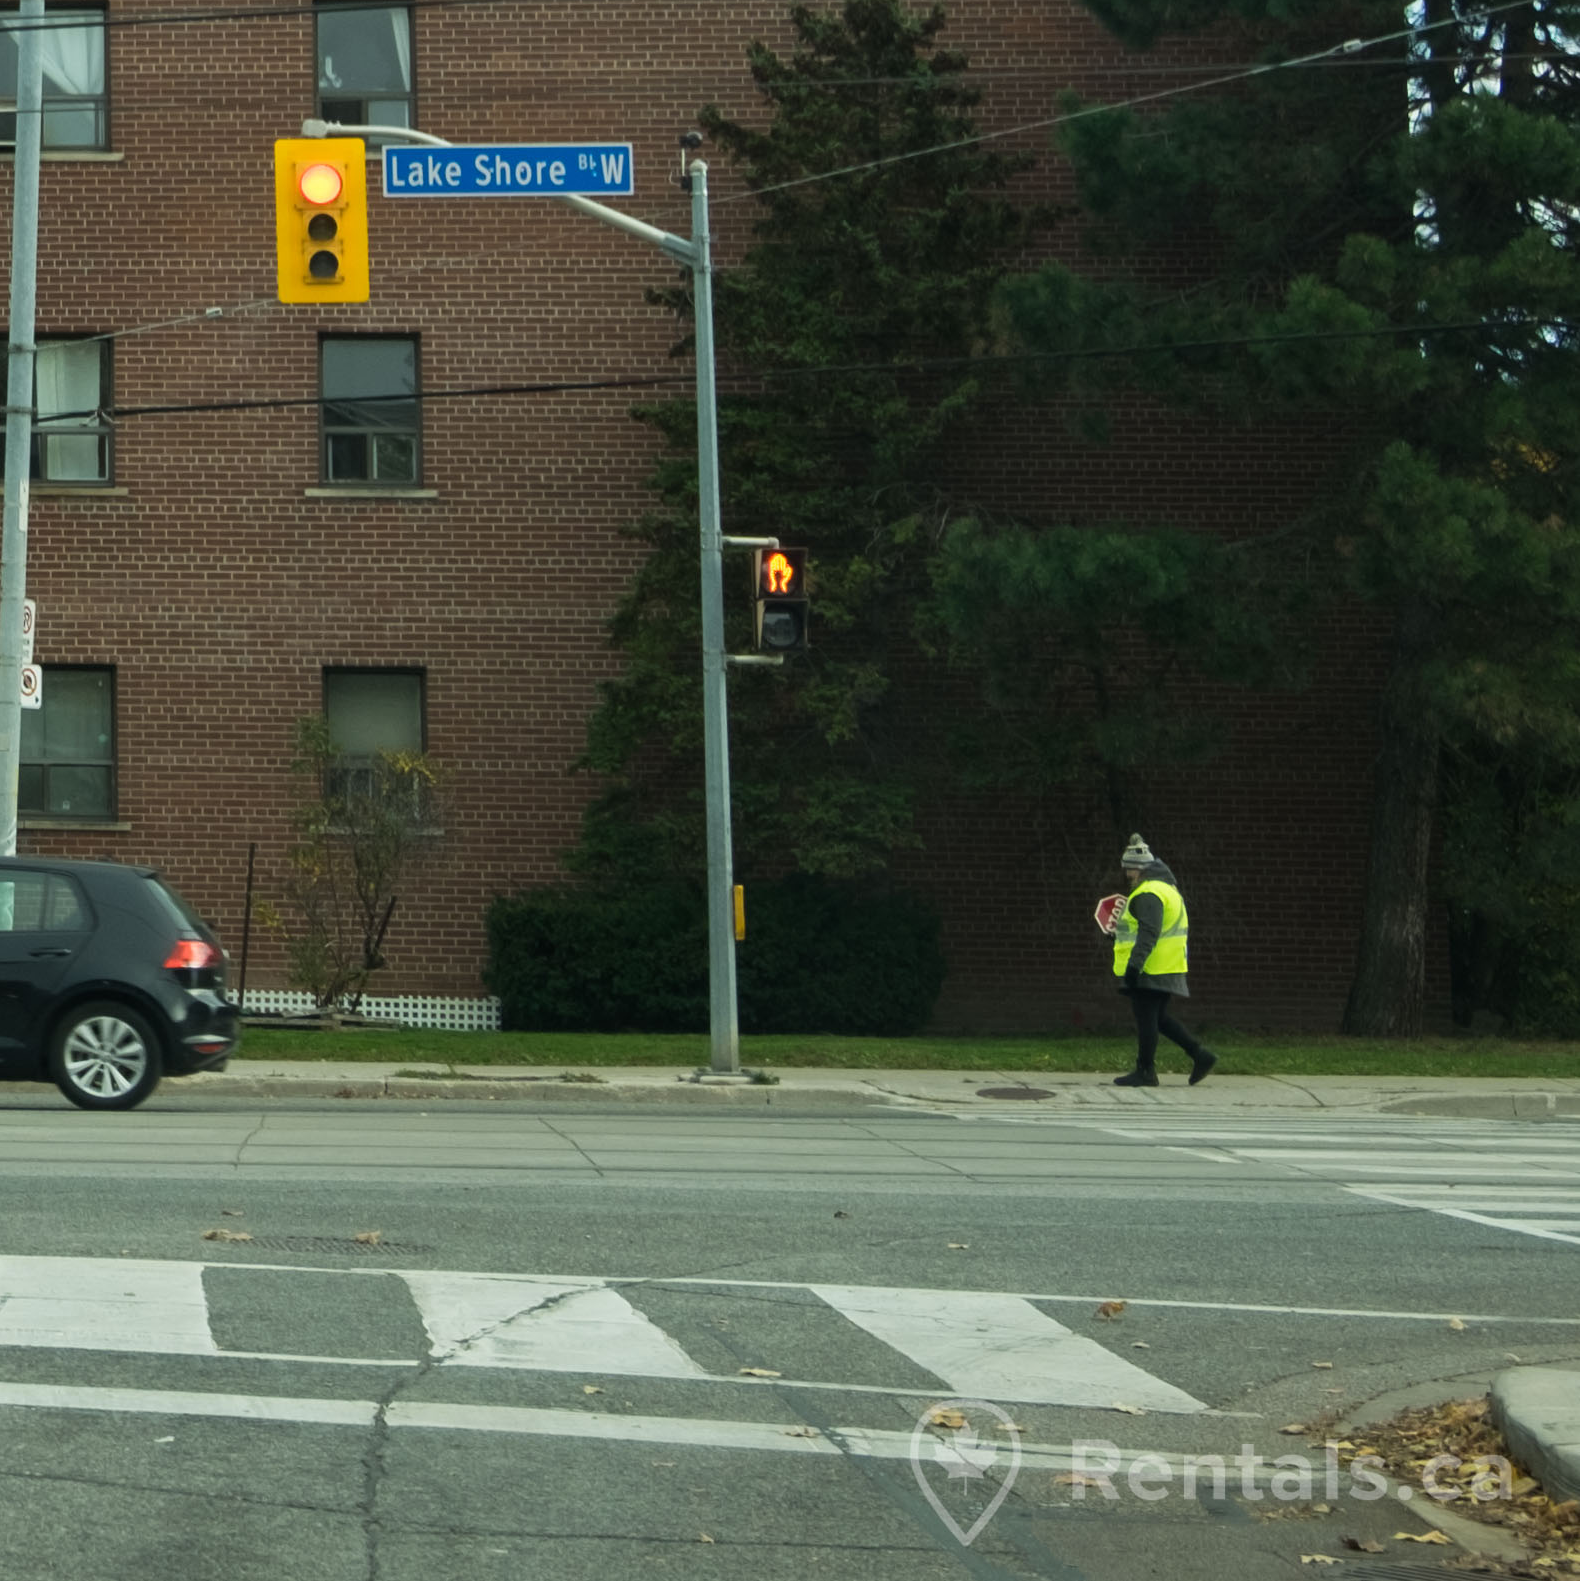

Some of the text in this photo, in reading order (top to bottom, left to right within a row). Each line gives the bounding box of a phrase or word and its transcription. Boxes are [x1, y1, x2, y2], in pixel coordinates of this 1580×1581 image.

[391, 155, 462, 187] Lake
[474, 154, 566, 186] Shore
[600, 154, 624, 184] W
